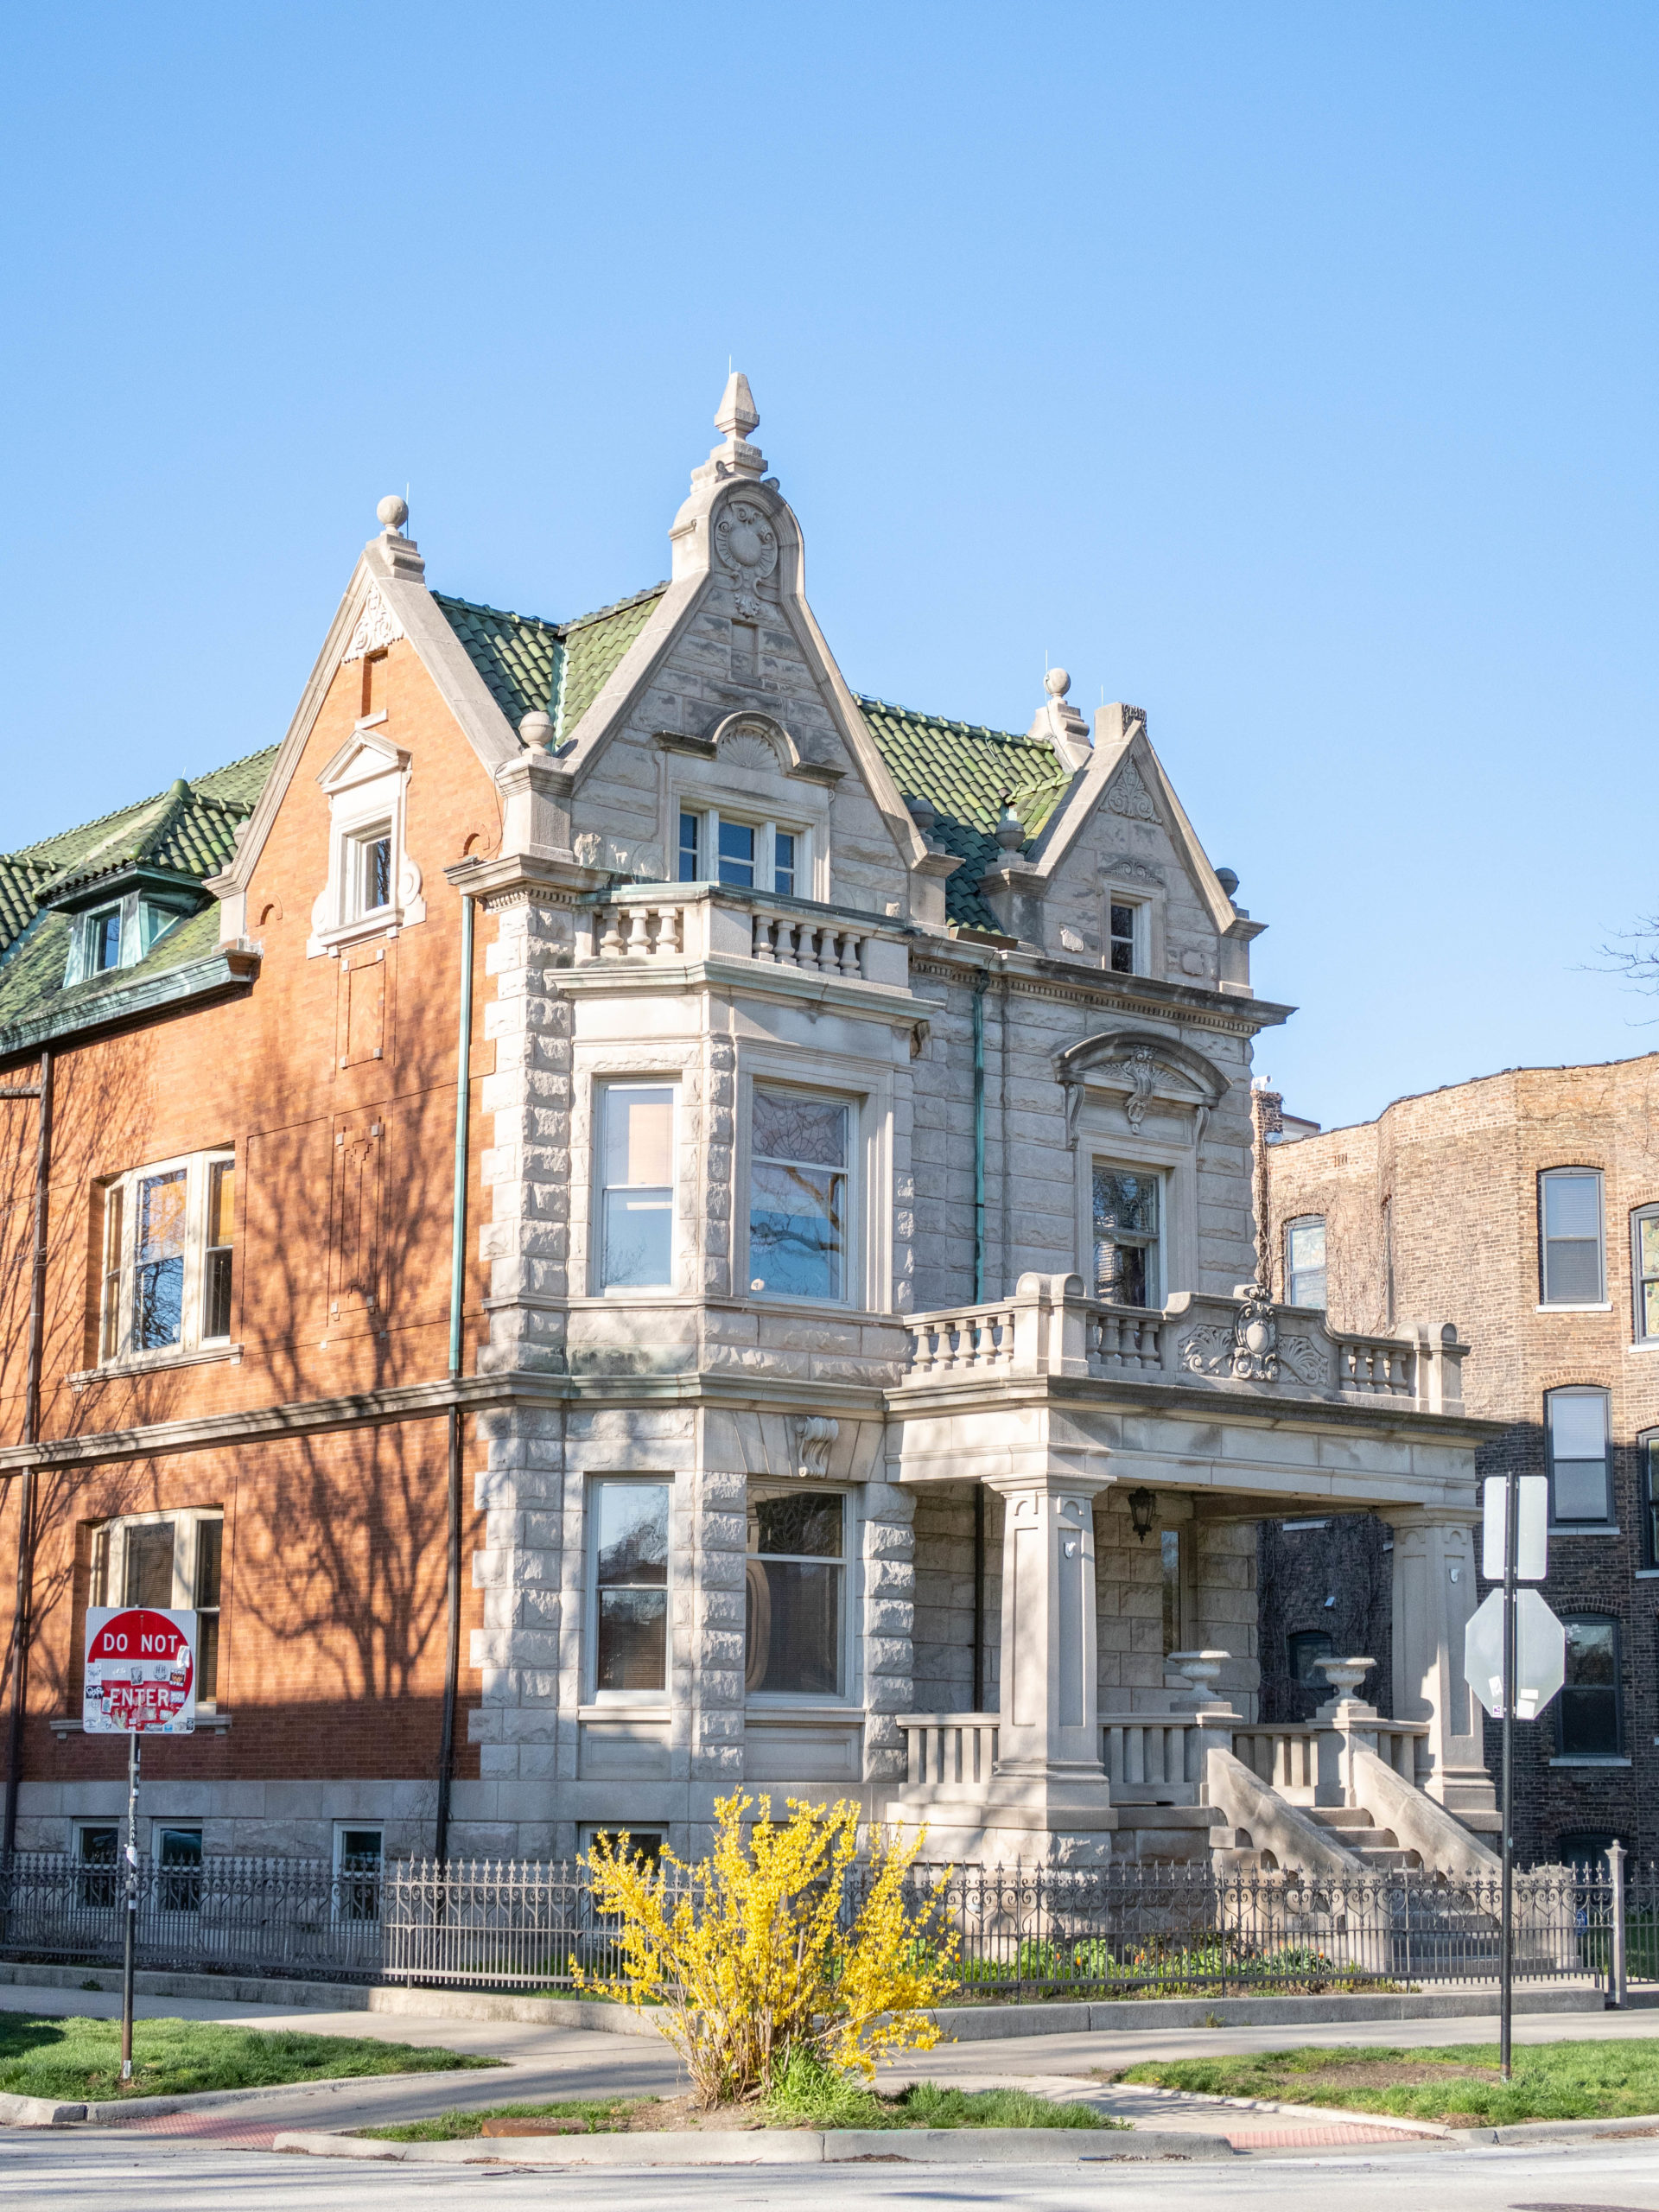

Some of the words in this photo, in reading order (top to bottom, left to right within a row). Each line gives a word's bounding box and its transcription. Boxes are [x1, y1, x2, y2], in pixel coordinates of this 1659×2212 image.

[103, 1633, 128, 1652] DO
[141, 1634, 178, 1653] NOT
[110, 1688, 169, 1707] ENTER
